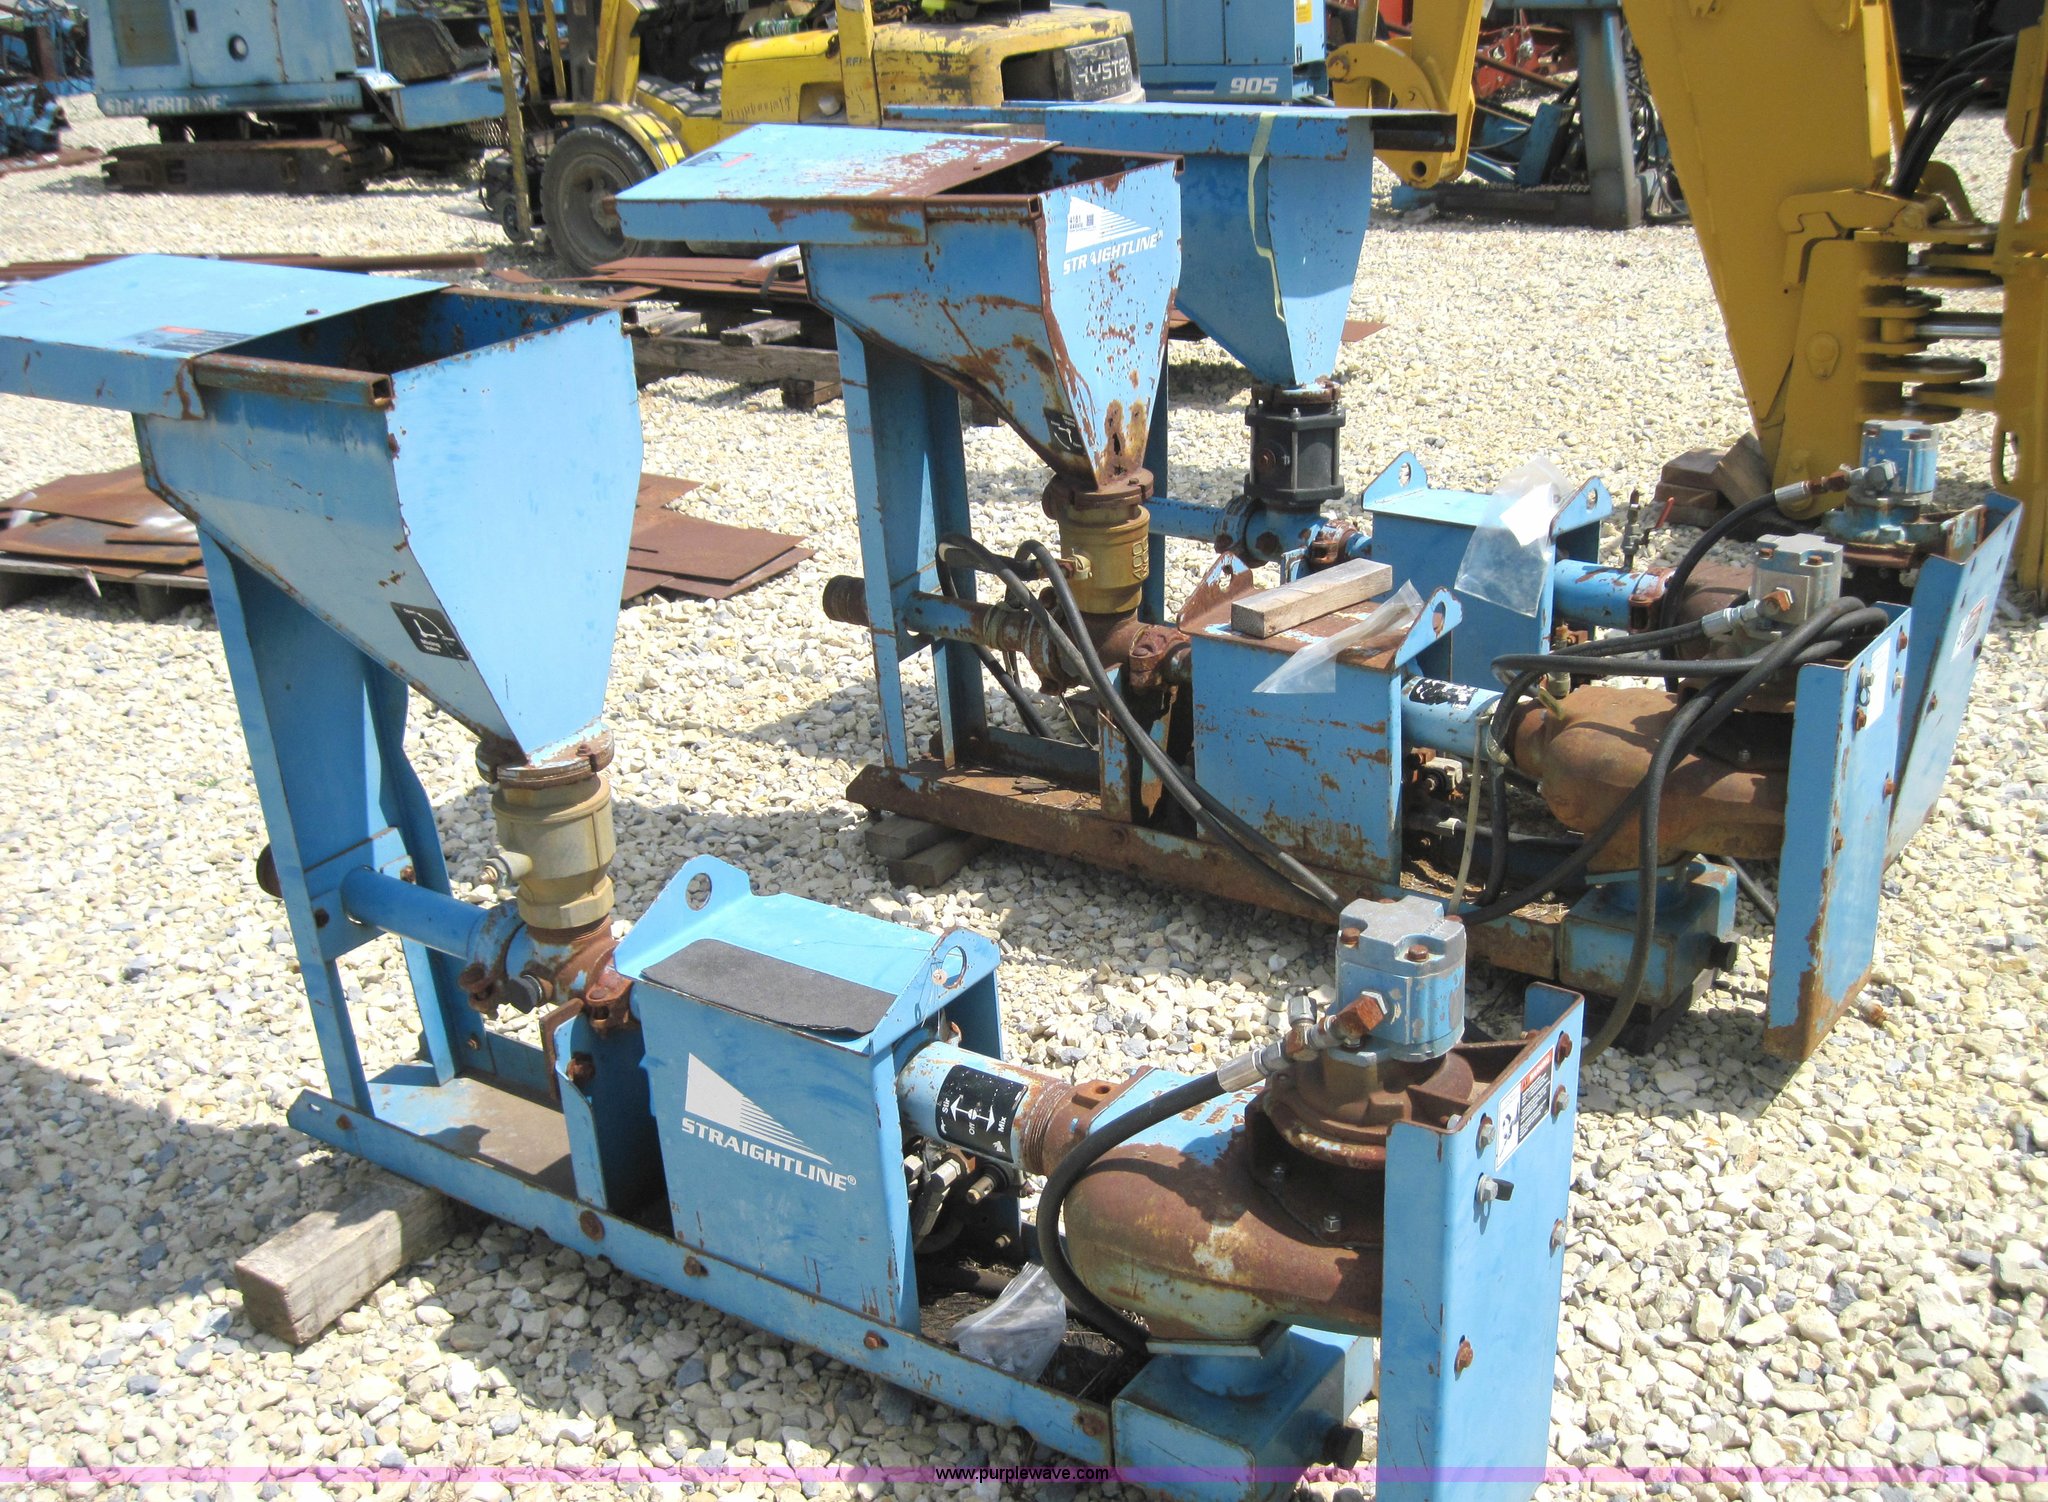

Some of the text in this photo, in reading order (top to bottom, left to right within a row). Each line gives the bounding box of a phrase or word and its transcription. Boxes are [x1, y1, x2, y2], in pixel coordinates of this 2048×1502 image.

[1230, 77, 1279, 94] 905
[942, 1098, 950, 1114] Stir
[997, 1116, 1007, 1132] Mix
